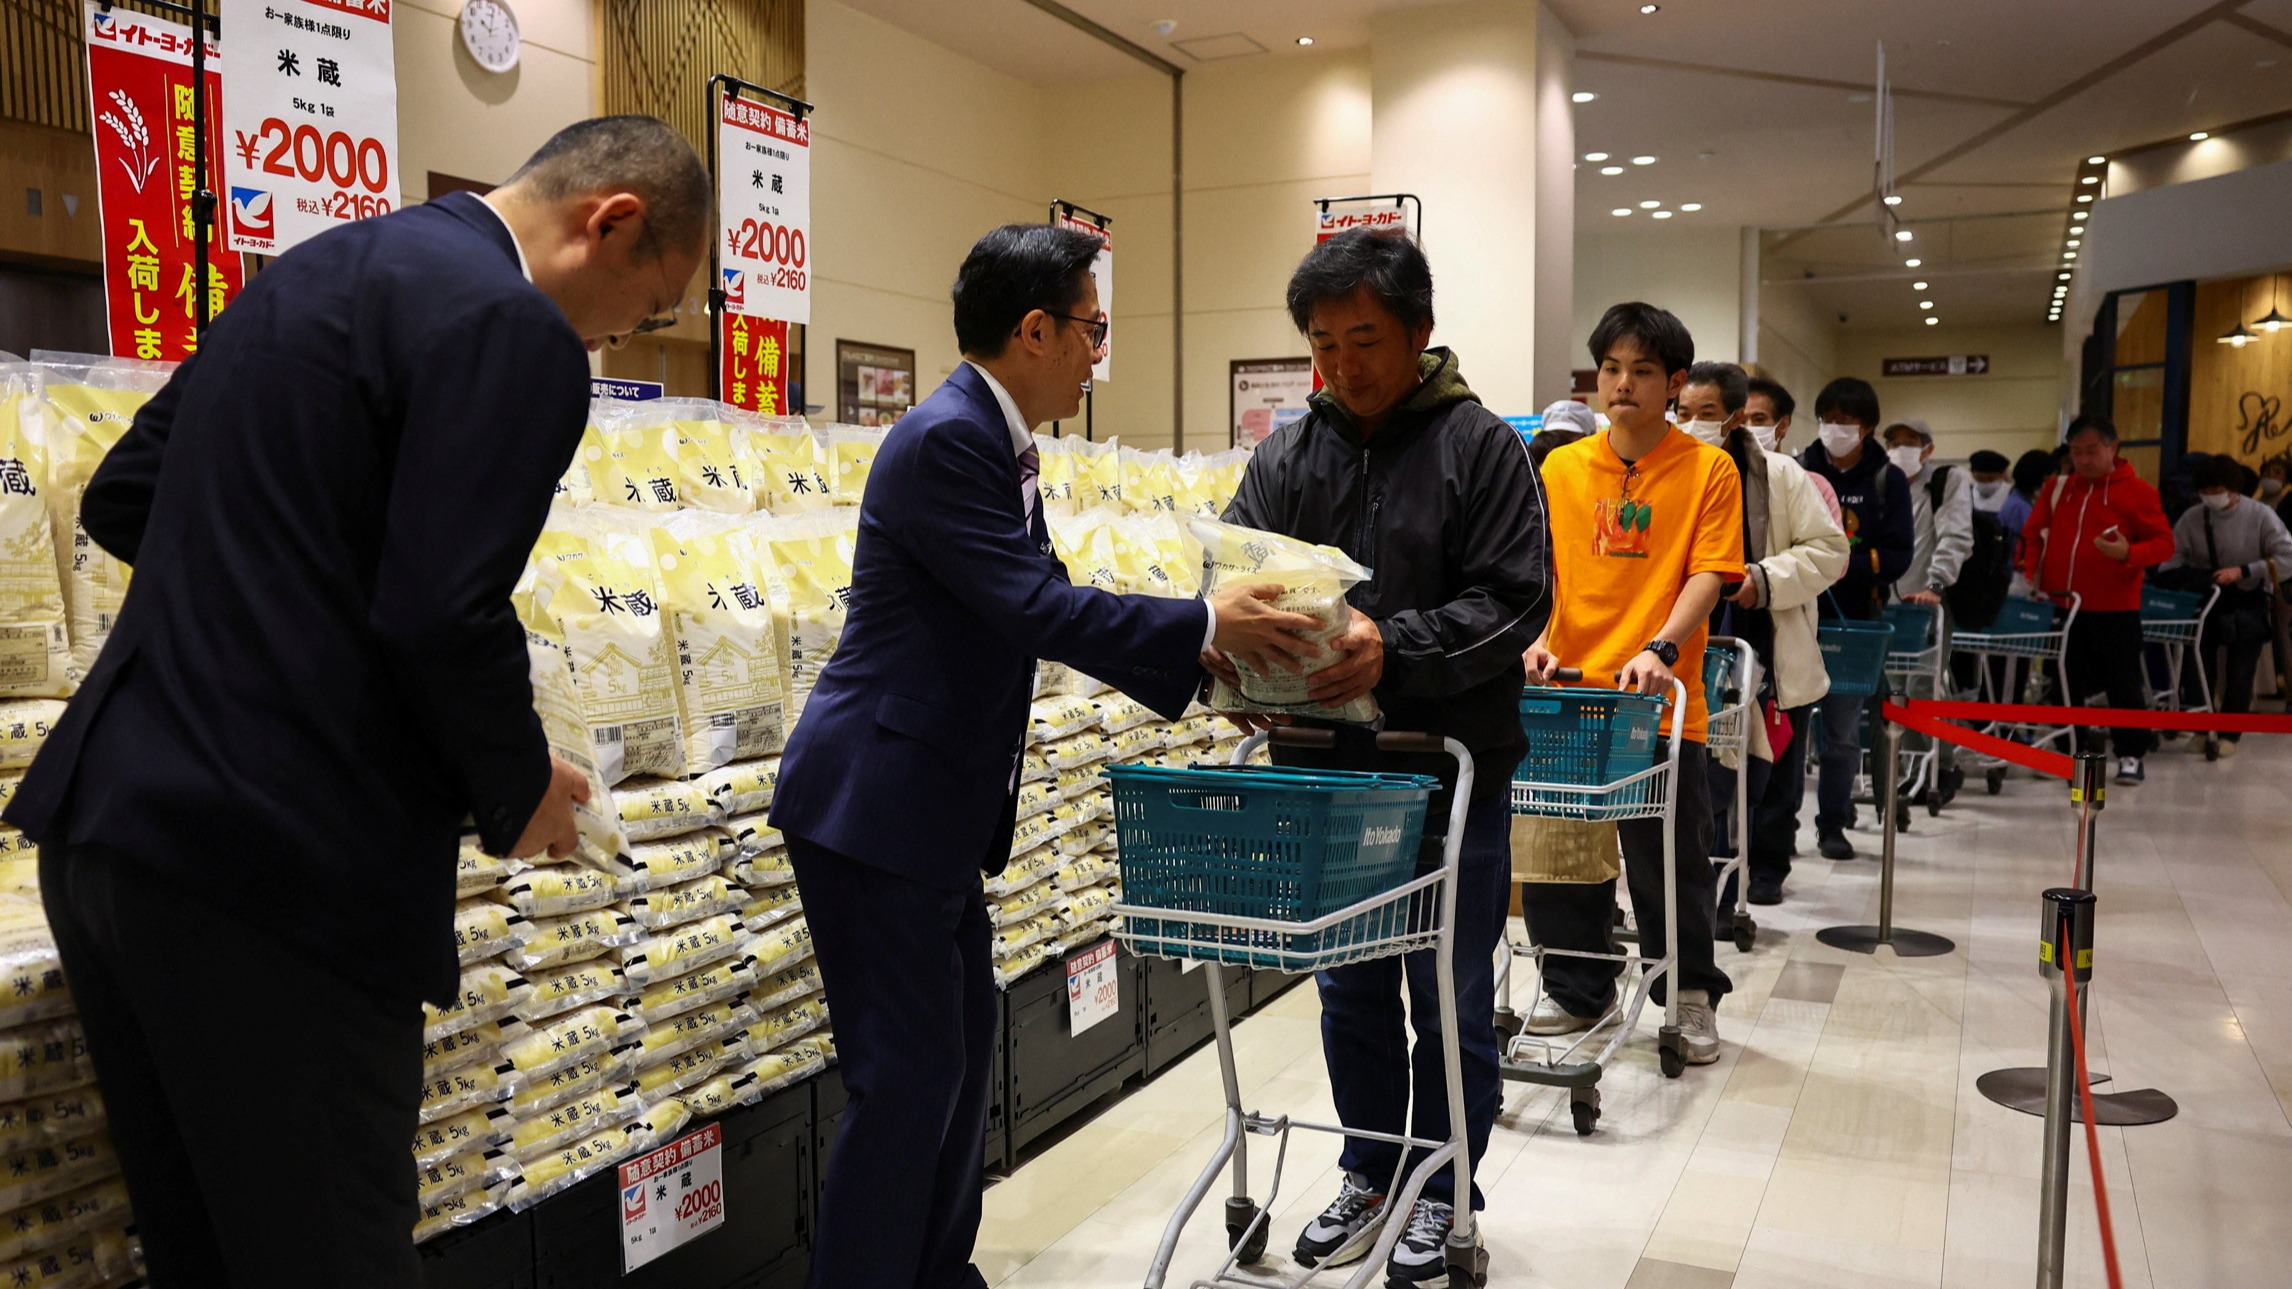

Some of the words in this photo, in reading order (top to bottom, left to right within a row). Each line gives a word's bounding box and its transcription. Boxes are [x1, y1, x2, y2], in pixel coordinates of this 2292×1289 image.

[293, 97, 315, 114] 5kg
[724, 101, 771, 131] 随意契約
[235, 117, 388, 194] ¥2000
[1336, 212, 1402, 227] イトーヨーカドー
[234, 238, 275, 249] イトーヨーカドー
[727, 218, 805, 268] ¥2000
[590, 382, 640, 398] 販売について
[470, 926, 489, 941] 5kg
[702, 932, 719, 945] 5kg
[580, 973, 598, 987] 5kg
[701, 973, 718, 986] 5kg
[467, 991, 485, 1006] 5kg
[699, 1012, 717, 1025] 5kg
[460, 1031, 480, 1046] 5kg
[582, 1025, 600, 1040] 5kg
[582, 1060, 600, 1075] 5kg
[455, 1076, 475, 1091] 5kg
[582, 1101, 601, 1115] 5kg
[449, 1125, 469, 1140] 5kg
[592, 1139, 613, 1153] 5kg
[446, 1162, 465, 1177] 5kg
[626, 1148, 677, 1184] 随意契約
[675, 1180, 721, 1221] ¥2000
